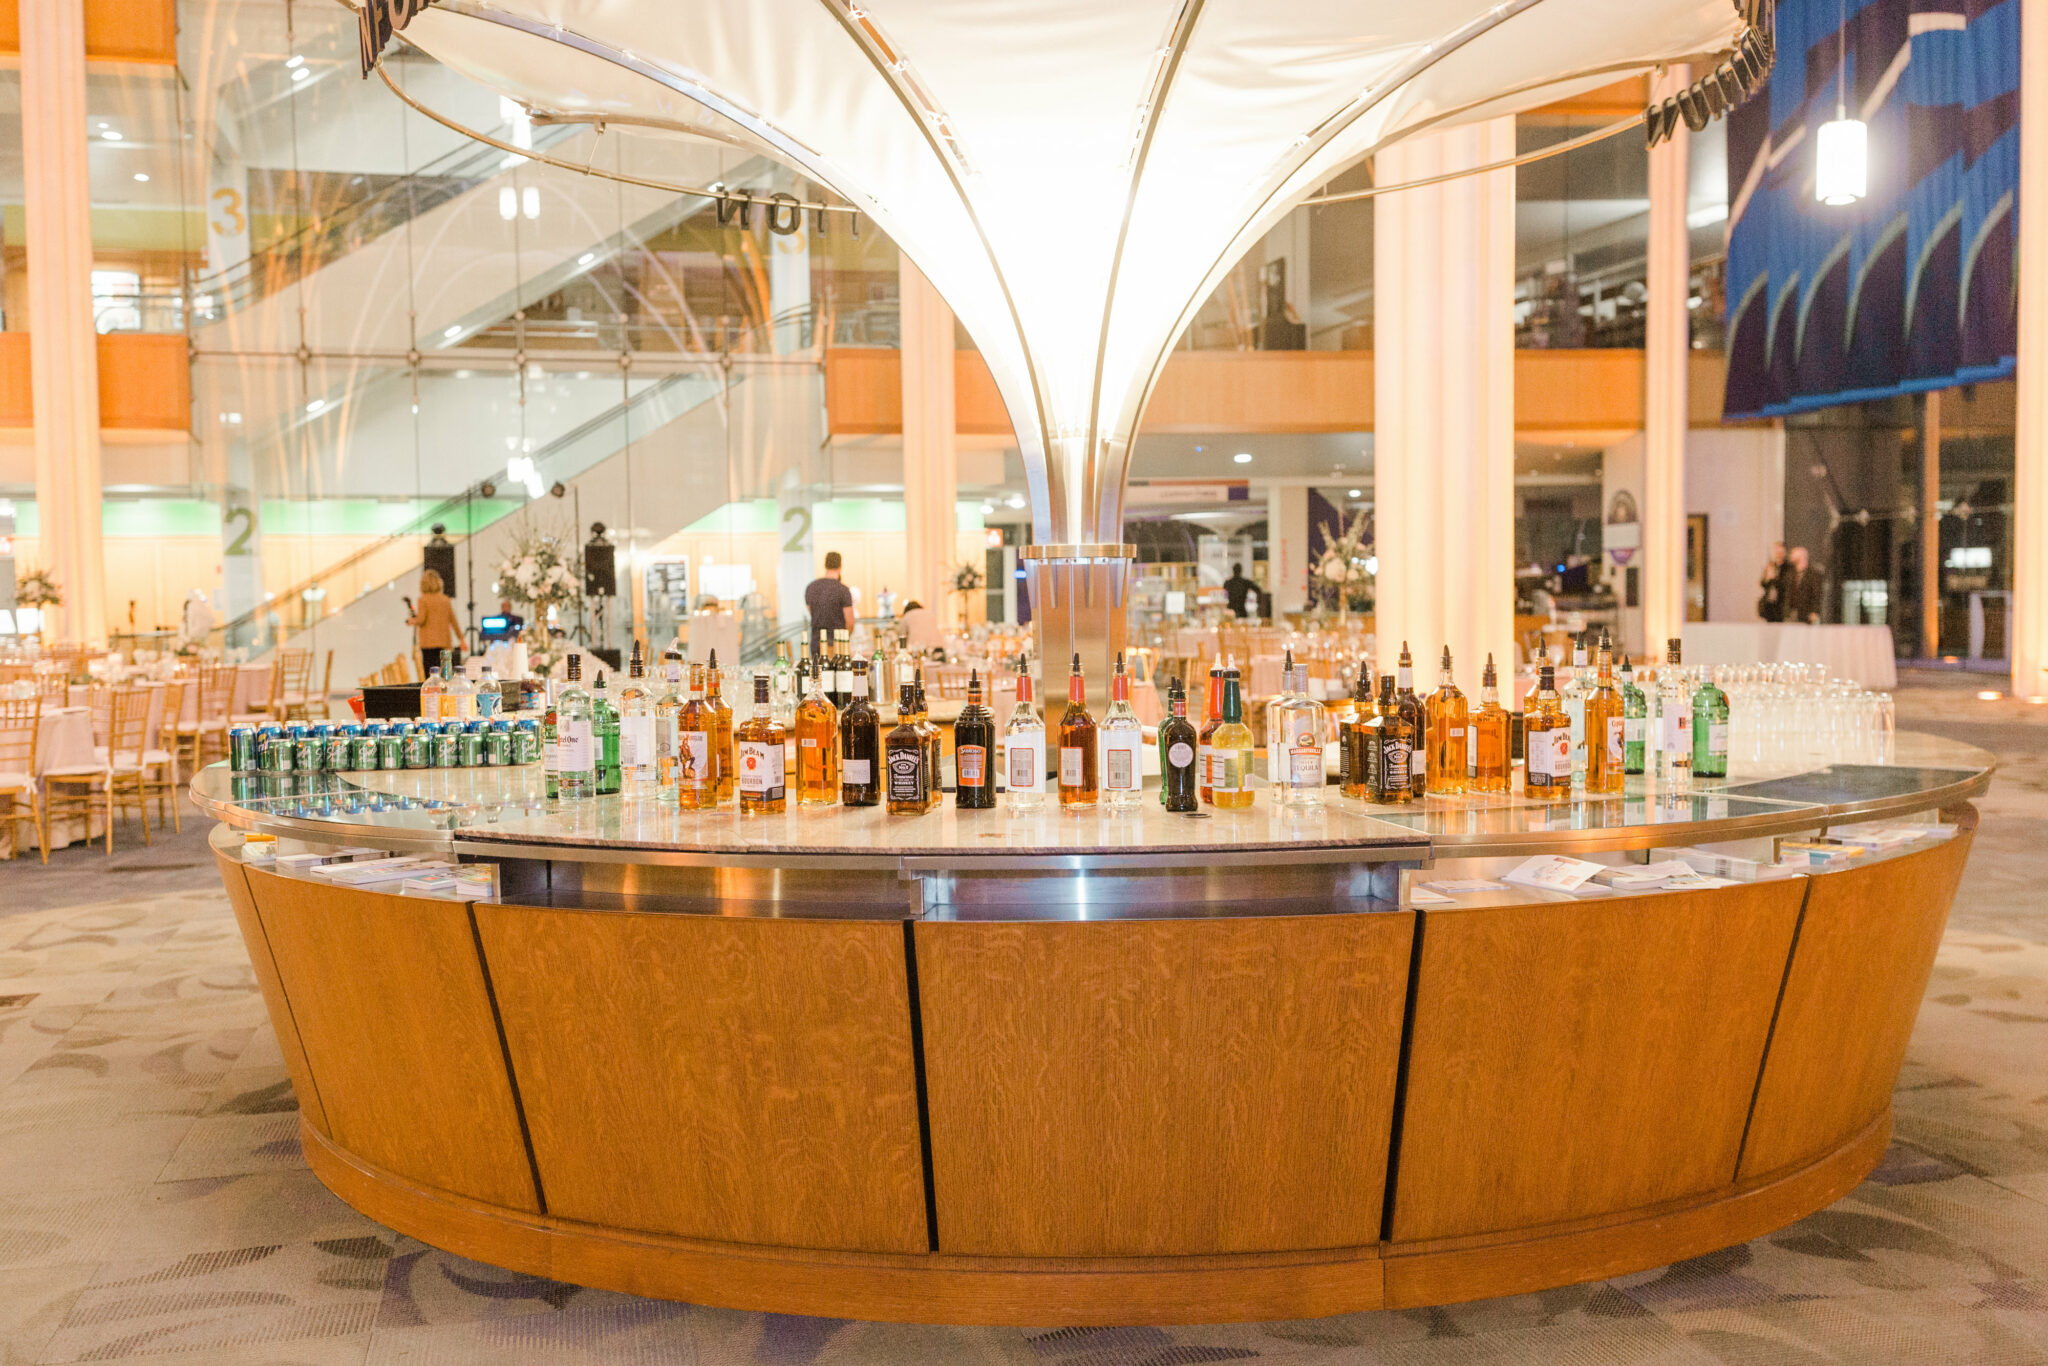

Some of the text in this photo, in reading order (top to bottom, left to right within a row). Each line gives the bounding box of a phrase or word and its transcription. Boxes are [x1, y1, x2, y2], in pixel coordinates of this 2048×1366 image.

[212, 187, 246, 237] 3
[224, 507, 256, 556] 2
[783, 506, 812, 552] 2
[887, 753, 900, 764] JACK
